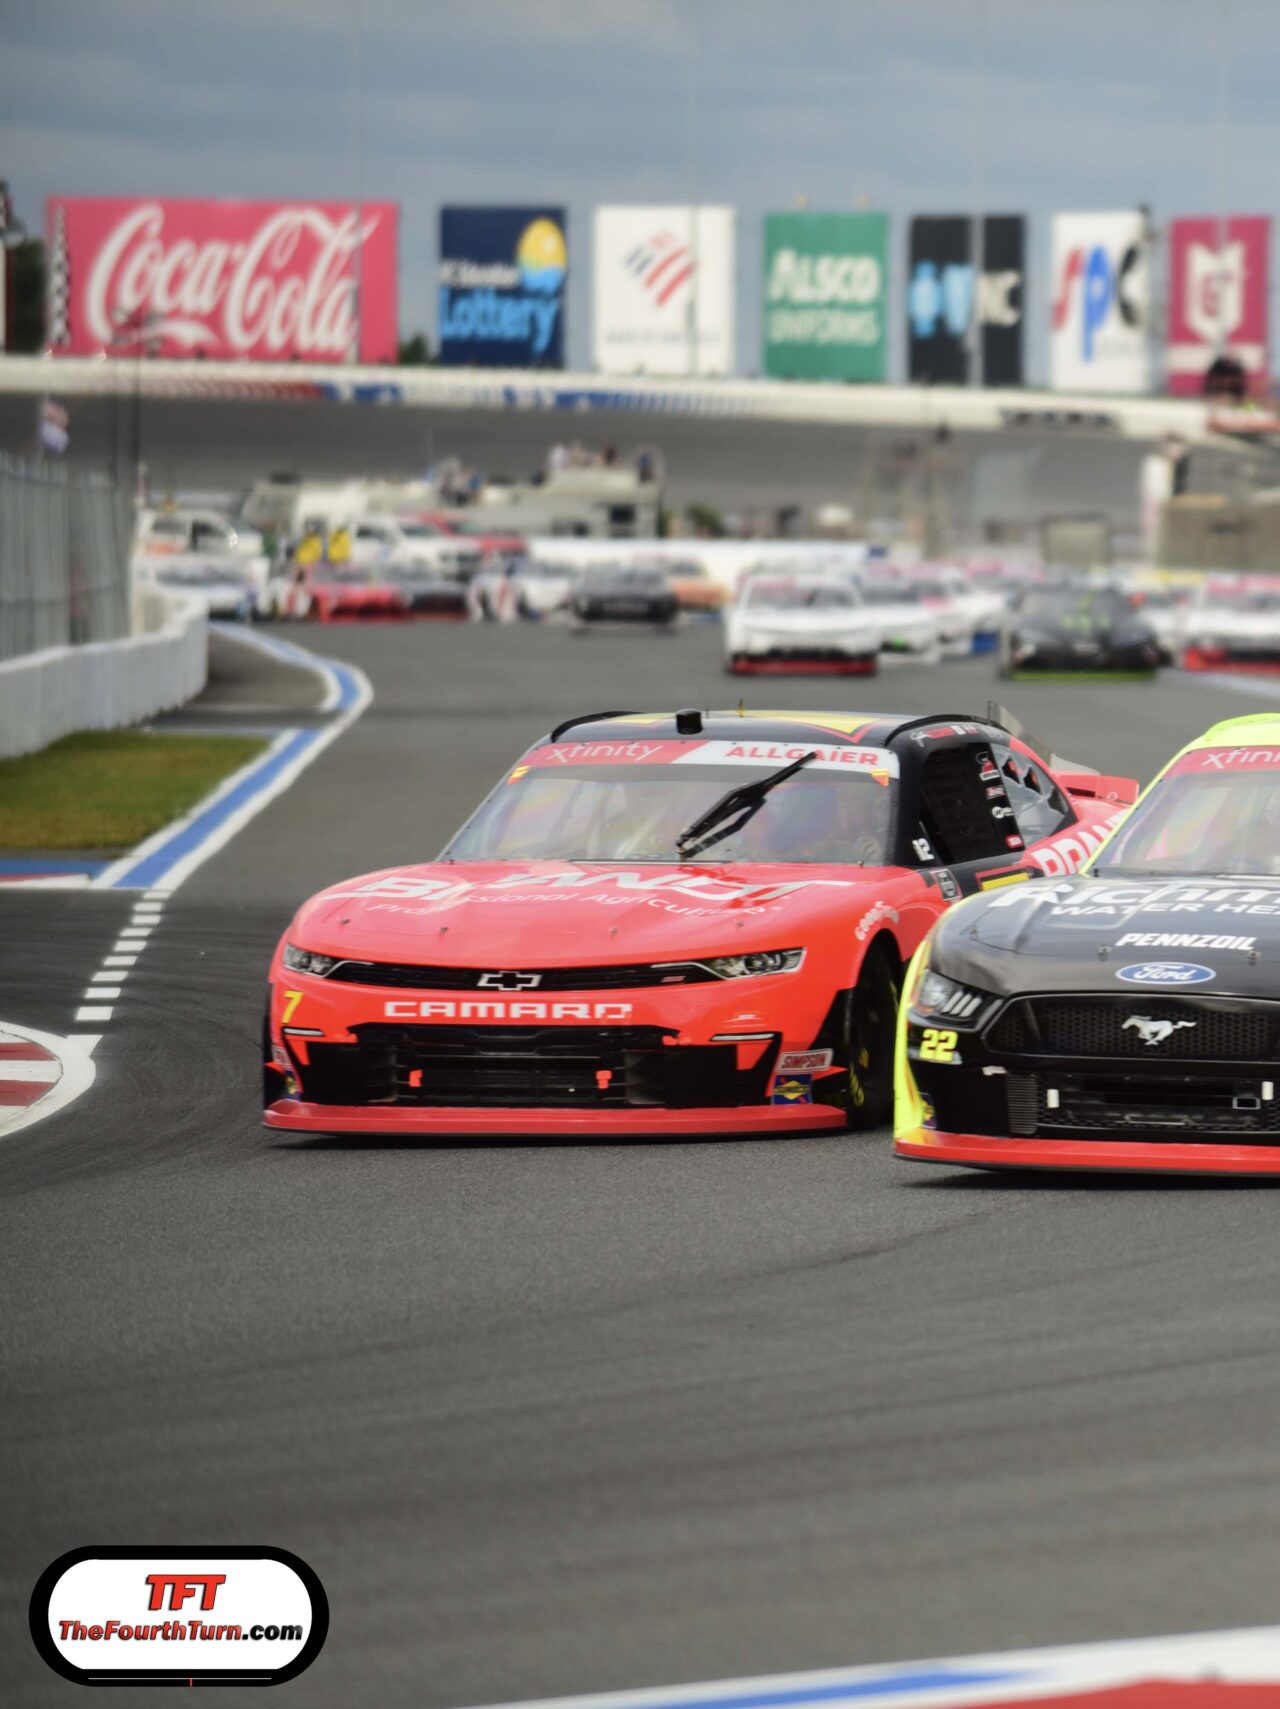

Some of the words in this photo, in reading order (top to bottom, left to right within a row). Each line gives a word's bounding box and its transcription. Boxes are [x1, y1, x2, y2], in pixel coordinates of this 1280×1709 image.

[86, 203, 382, 354] Coca-Cola
[725, 745, 879, 767] ALLGAIER
[1051, 903, 1205, 915] WATER
[1115, 933, 1256, 950] PENNZOIL
[281, 989, 304, 1024] 7
[383, 1001, 633, 1020] CAMARO
[919, 1028, 958, 1061] 22
